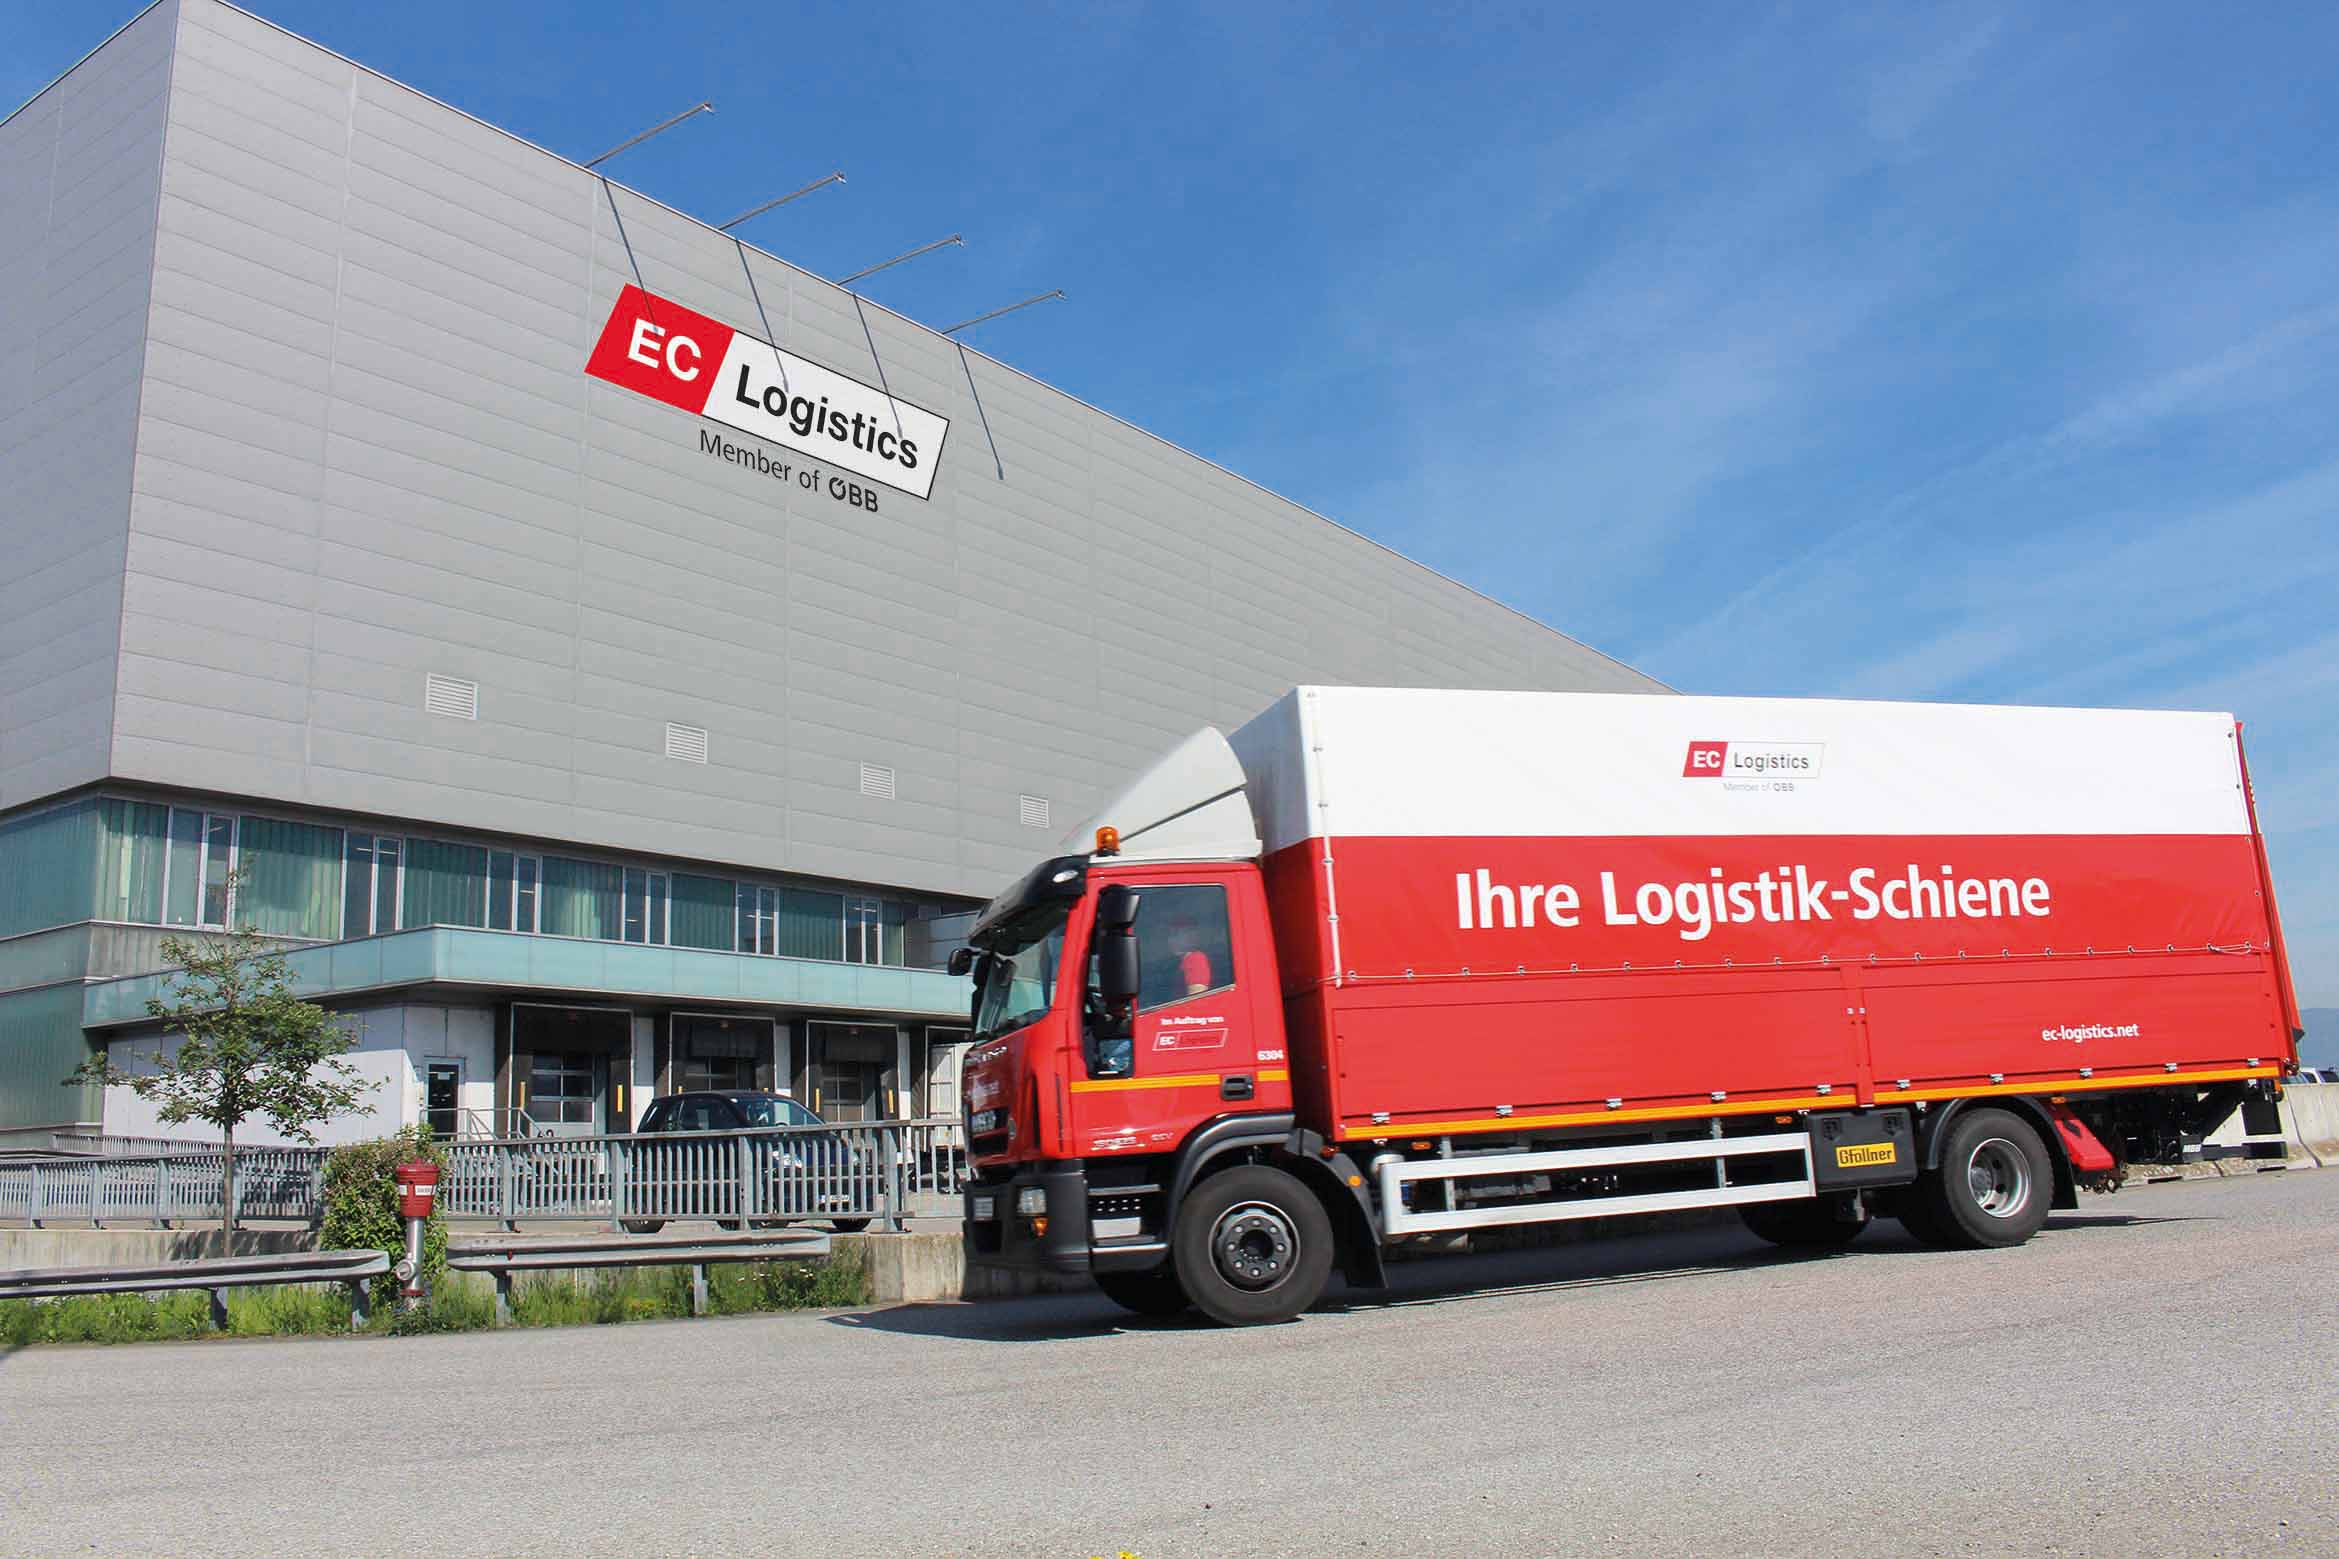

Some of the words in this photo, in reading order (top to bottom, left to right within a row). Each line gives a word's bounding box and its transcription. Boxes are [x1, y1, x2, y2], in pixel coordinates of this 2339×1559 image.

[627, 318, 701, 382] EC
[735, 364, 919, 470] Logistics
[700, 429, 793, 482] Member
[799, 469, 821, 492] of
[1692, 750, 1721, 769] EC
[1733, 752, 1809, 773] Logistics
[1456, 868, 1581, 930] Ihre
[1600, 864, 2052, 942] Logistik-Schiene
[1159, 1036, 1176, 1047] EC
[2042, 1023, 2140, 1044] ec-logistics.net
